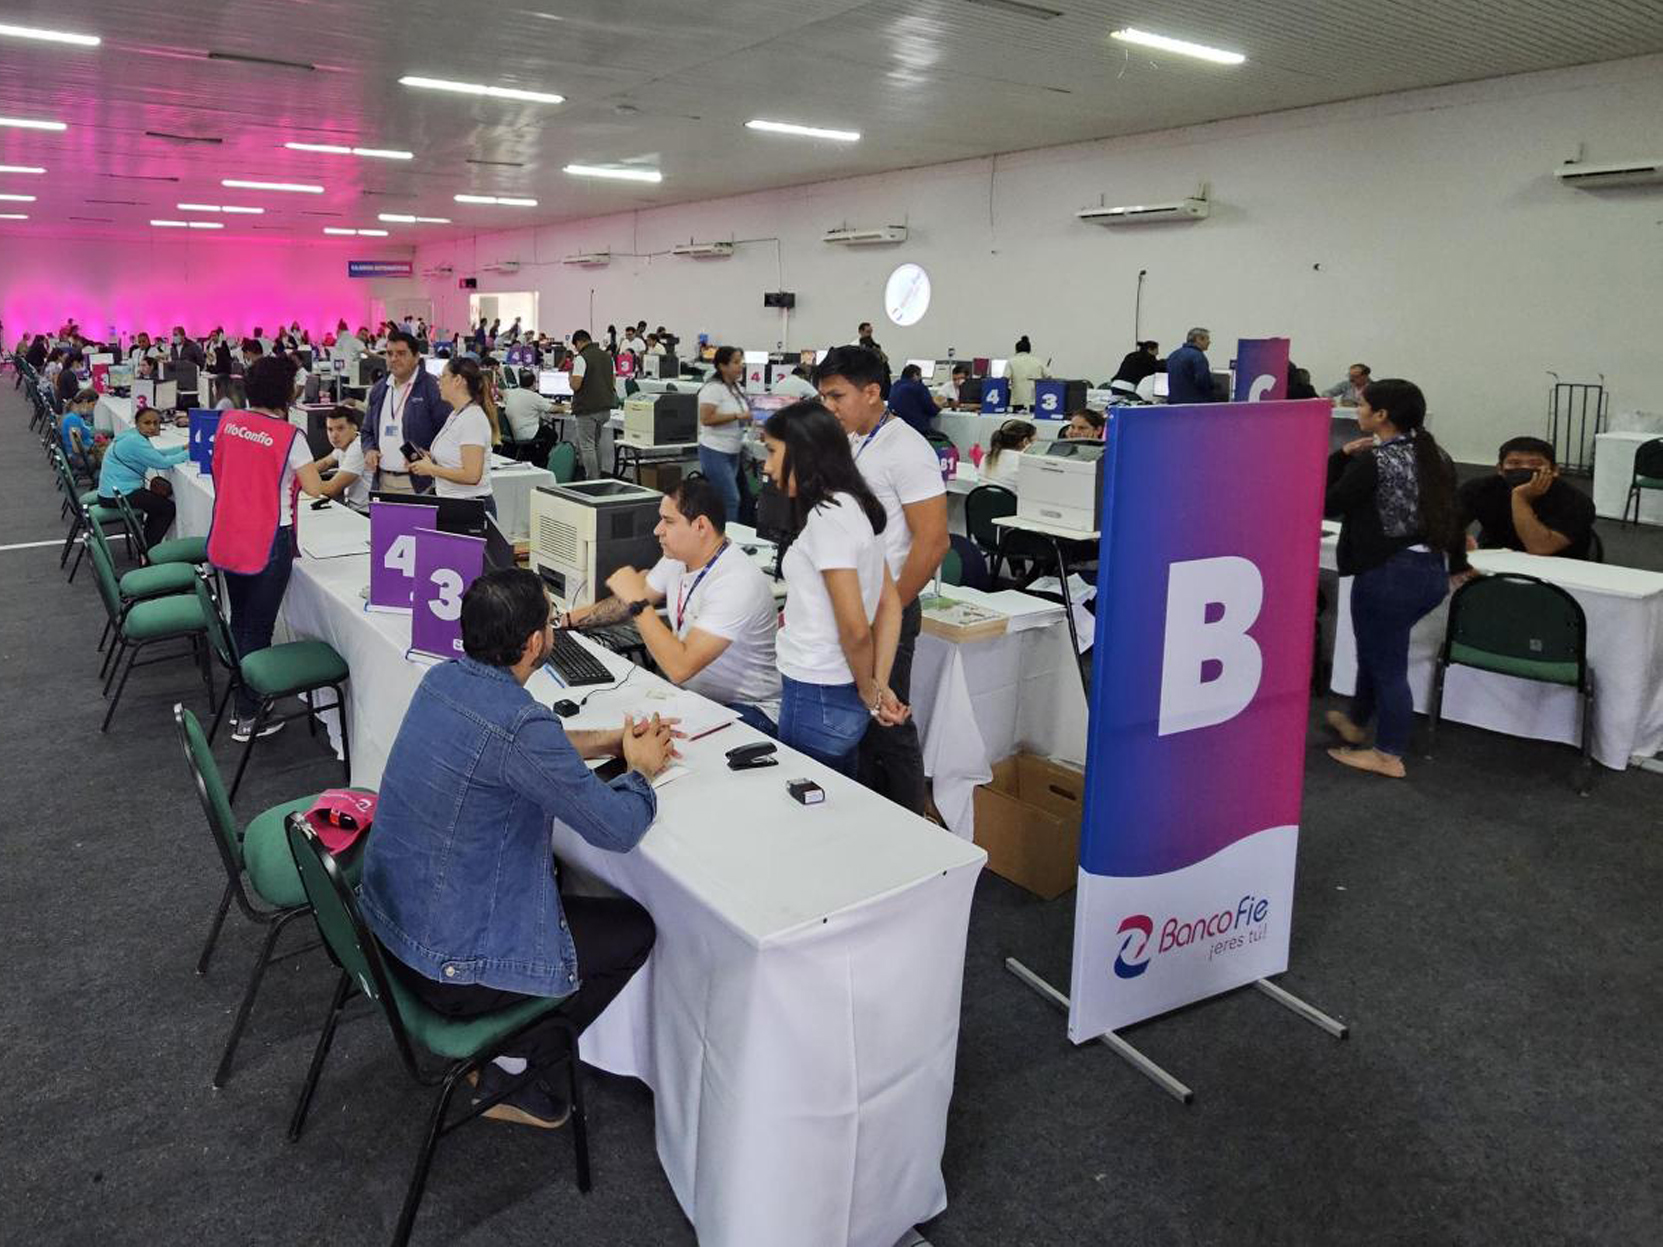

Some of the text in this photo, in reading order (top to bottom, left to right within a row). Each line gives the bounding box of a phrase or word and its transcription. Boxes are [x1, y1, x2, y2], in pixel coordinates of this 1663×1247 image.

[621, 361, 630, 372] 3
[751, 372, 761, 382] 4
[986, 389, 1000, 404] 4
[1041, 393, 1058, 410] 3
[384, 534, 416, 578] 4
[428, 568, 464, 621] 3
[1158, 555, 1264, 737] B
